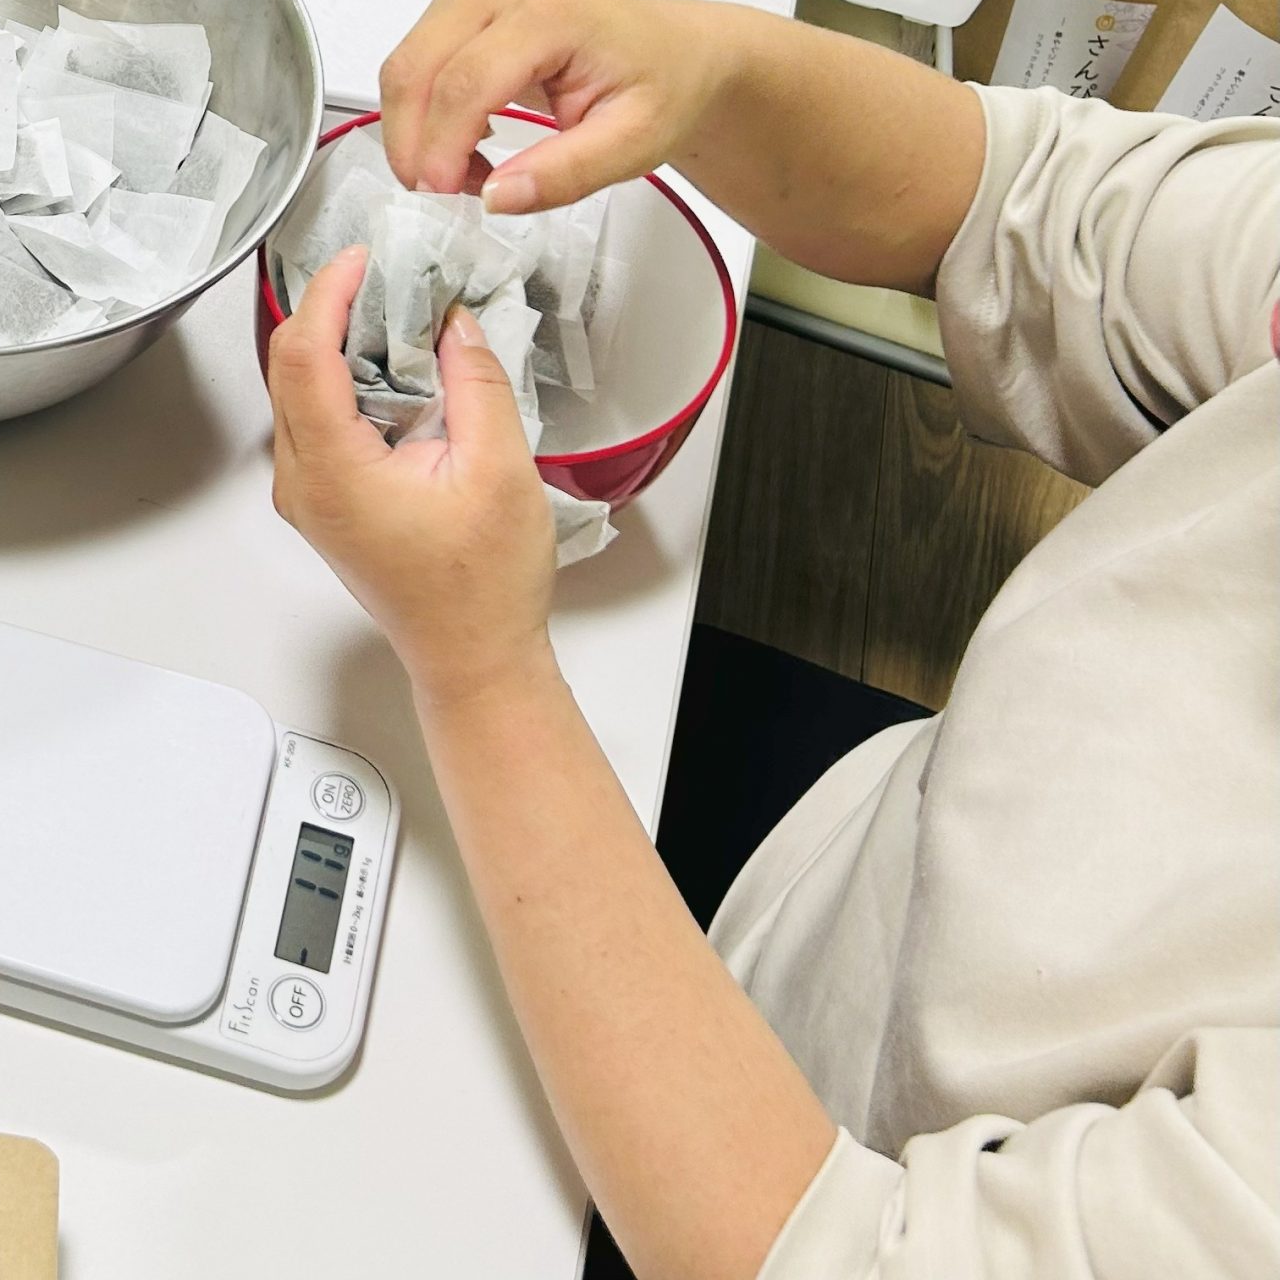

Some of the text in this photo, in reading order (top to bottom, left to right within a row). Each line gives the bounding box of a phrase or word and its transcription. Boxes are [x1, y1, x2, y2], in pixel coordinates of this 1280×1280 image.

[321, 783, 337, 805] ON
[340, 784, 357, 815] ZERO
[227, 976, 260, 1035] FitScan
[288, 983, 307, 1019] OFF
